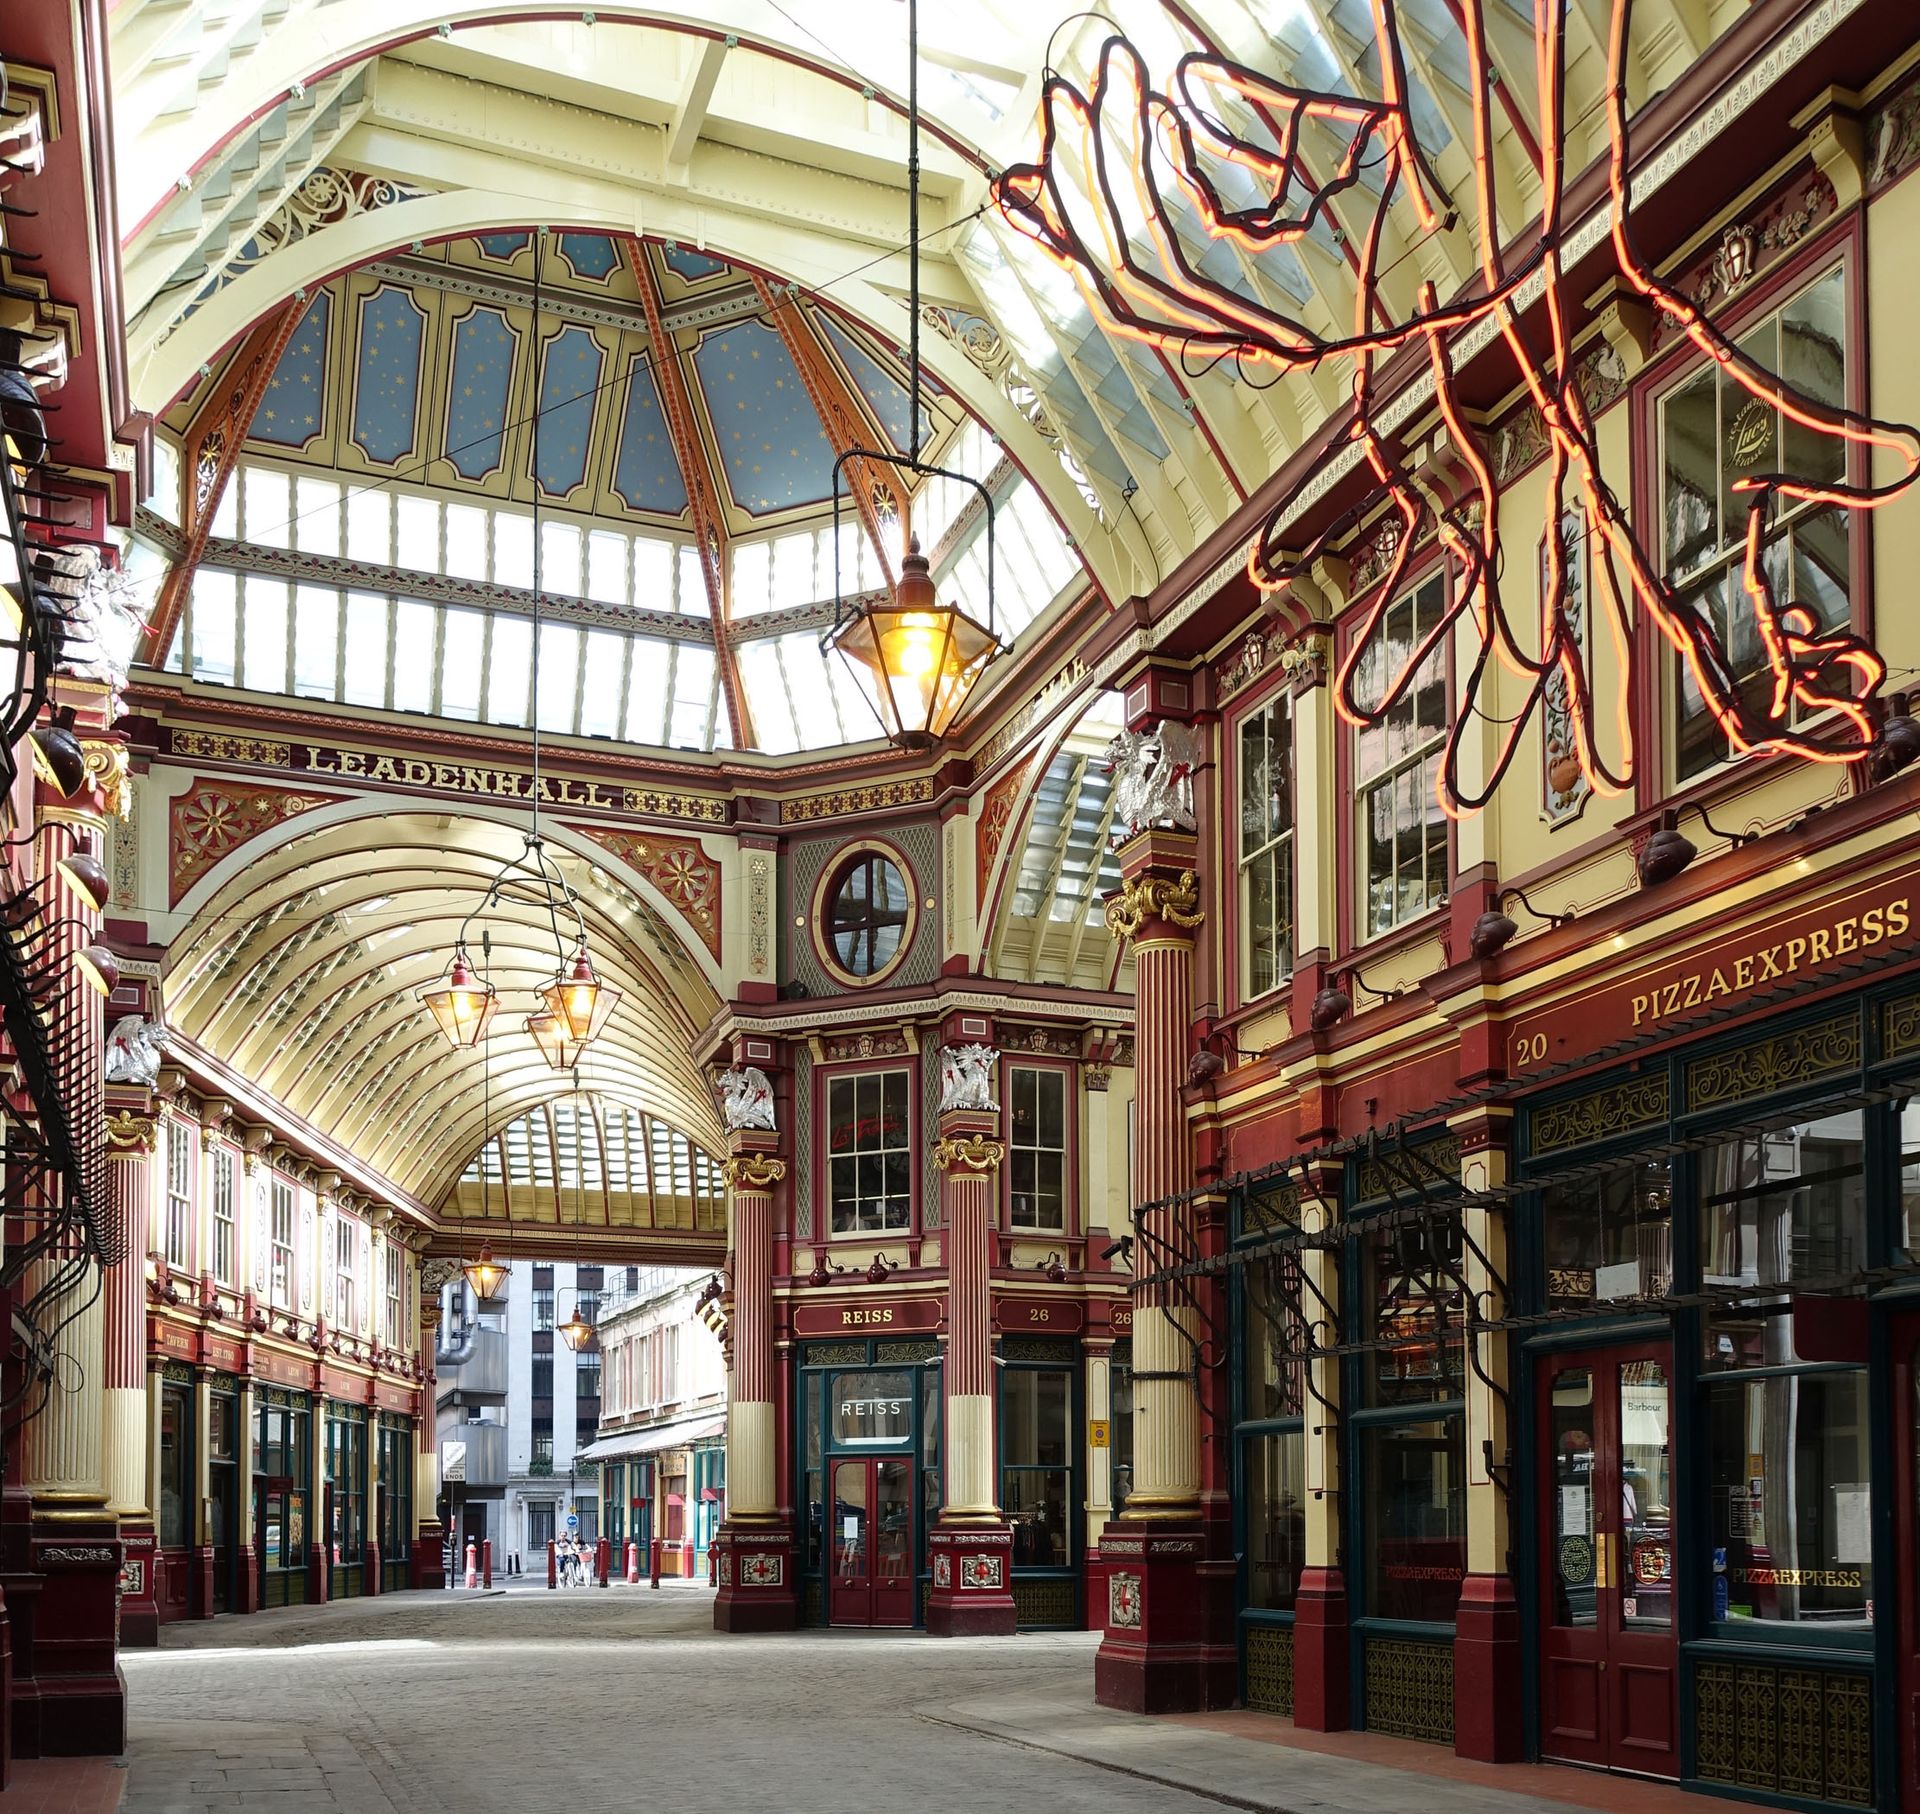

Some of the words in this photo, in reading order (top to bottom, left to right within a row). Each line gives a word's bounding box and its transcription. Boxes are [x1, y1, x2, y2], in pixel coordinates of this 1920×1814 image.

[306, 747, 612, 808] LEADENHALL
[1631, 898, 1910, 1027] PIZZAEXPRESS
[1516, 1032, 1548, 1067] 20
[842, 1309, 894, 1325] REISS
[1030, 1308, 1049, 1322] 26
[1115, 1312, 1133, 1325] 26
[166, 1333, 189, 1350] TAVERN
[841, 1401, 901, 1416] REISS
[1627, 1402, 1661, 1411] Barbour
[1384, 1566, 1463, 1582] PIZZAEXPRESS
[1731, 1568, 1862, 1588] PIZZAEXPRESS
